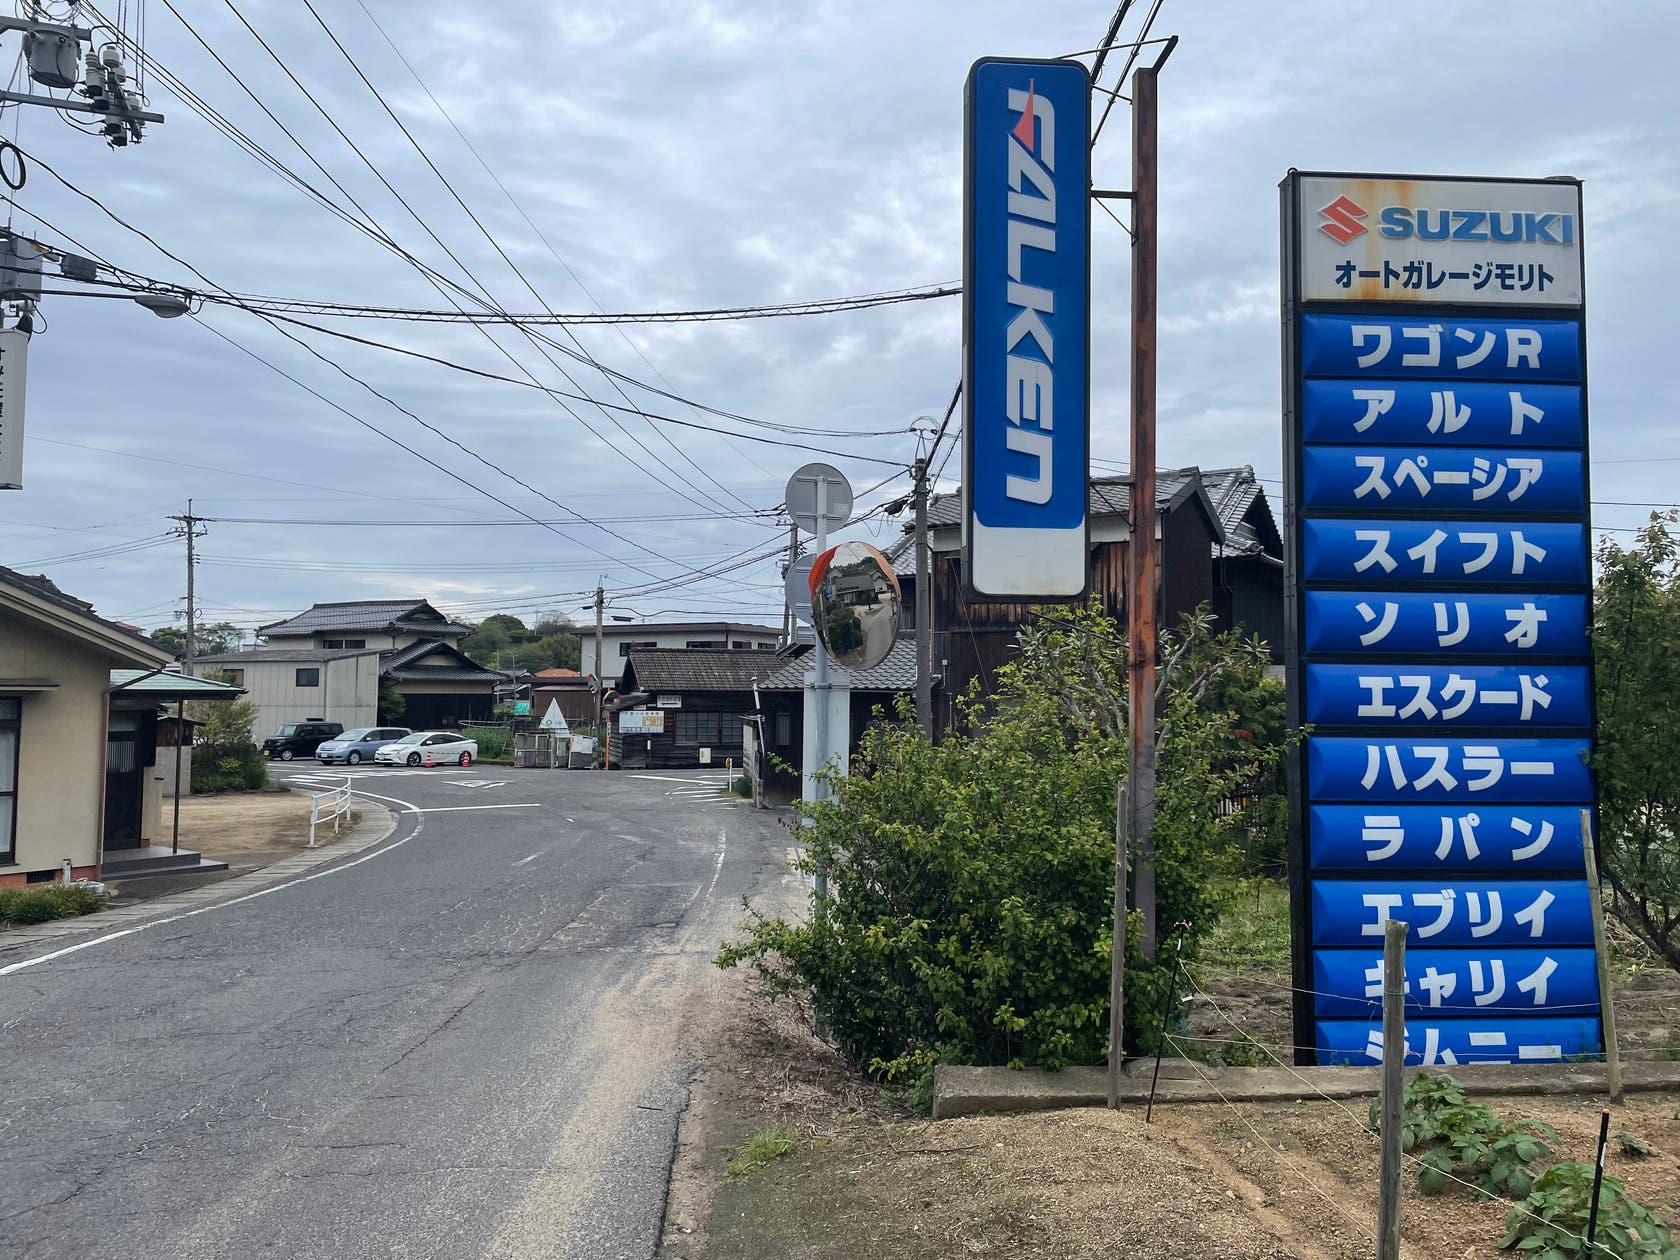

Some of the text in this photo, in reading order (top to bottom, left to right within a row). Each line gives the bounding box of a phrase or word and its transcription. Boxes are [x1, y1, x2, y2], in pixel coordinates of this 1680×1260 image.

[1379, 206, 1574, 245] SUZUKI
[1006, 78, 1057, 506] FALKEN
[1335, 260, 1554, 292] オートガレージモリト
[1351, 324, 1543, 370] ワゴンR
[1352, 389, 1545, 435] アルト
[1353, 455, 1543, 502] スペーシア
[1354, 528, 1547, 575] スイフト
[1355, 602, 1548, 648] ソリオ
[1357, 673, 1552, 721] エスクード
[1361, 745, 1555, 792] ハスラー
[1362, 812, 1555, 862] ラパン
[1361, 888, 1556, 939] エブリイ
